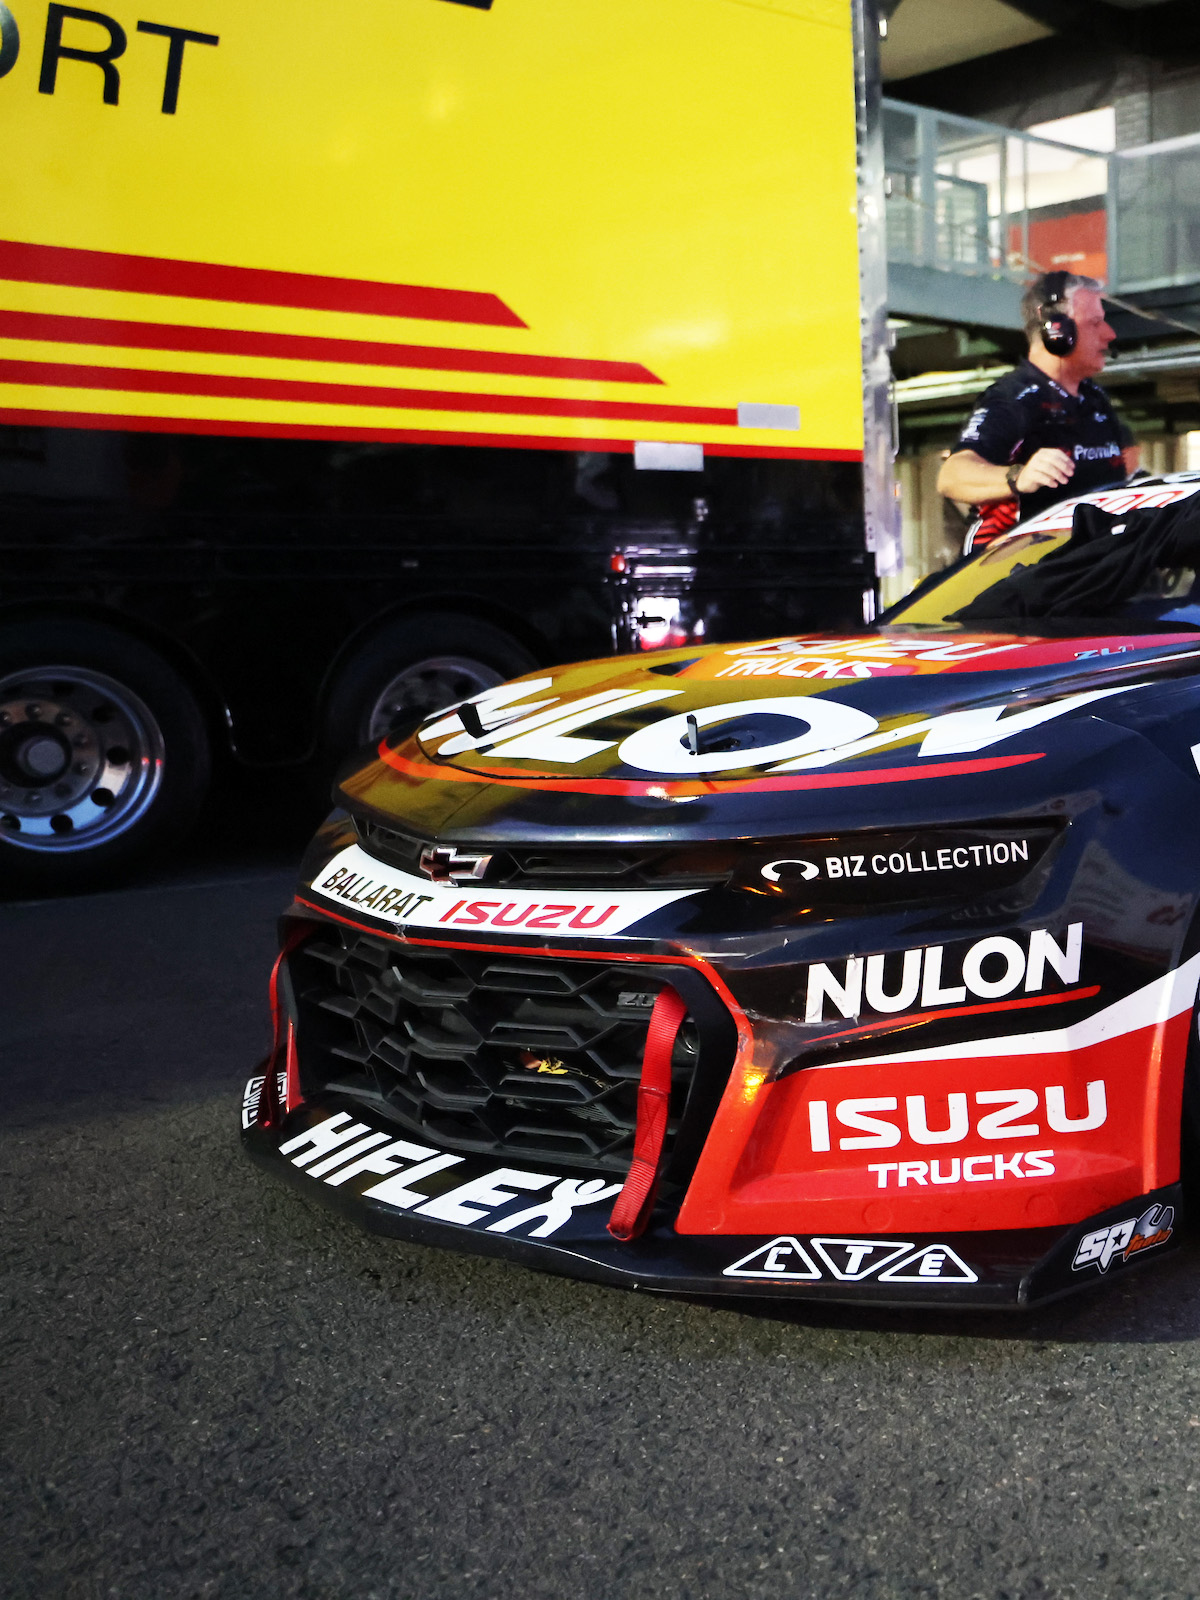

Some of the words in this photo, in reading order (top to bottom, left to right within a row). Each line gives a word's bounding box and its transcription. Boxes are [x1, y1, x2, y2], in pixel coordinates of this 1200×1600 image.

[715, 657, 894, 679] TRUCKS
[724, 640, 1028, 661] ISUZU
[826, 856, 867, 879] BIZ
[872, 840, 1029, 875] COLLECTION
[321, 867, 434, 918] BALLARAT
[439, 900, 620, 929] ISUZU
[804, 922, 1083, 1023] NULON
[808, 1080, 1107, 1152] ISUZU
[278, 1111, 623, 1239] HIFLEX
[867, 1149, 1056, 1189] TRUCKS
